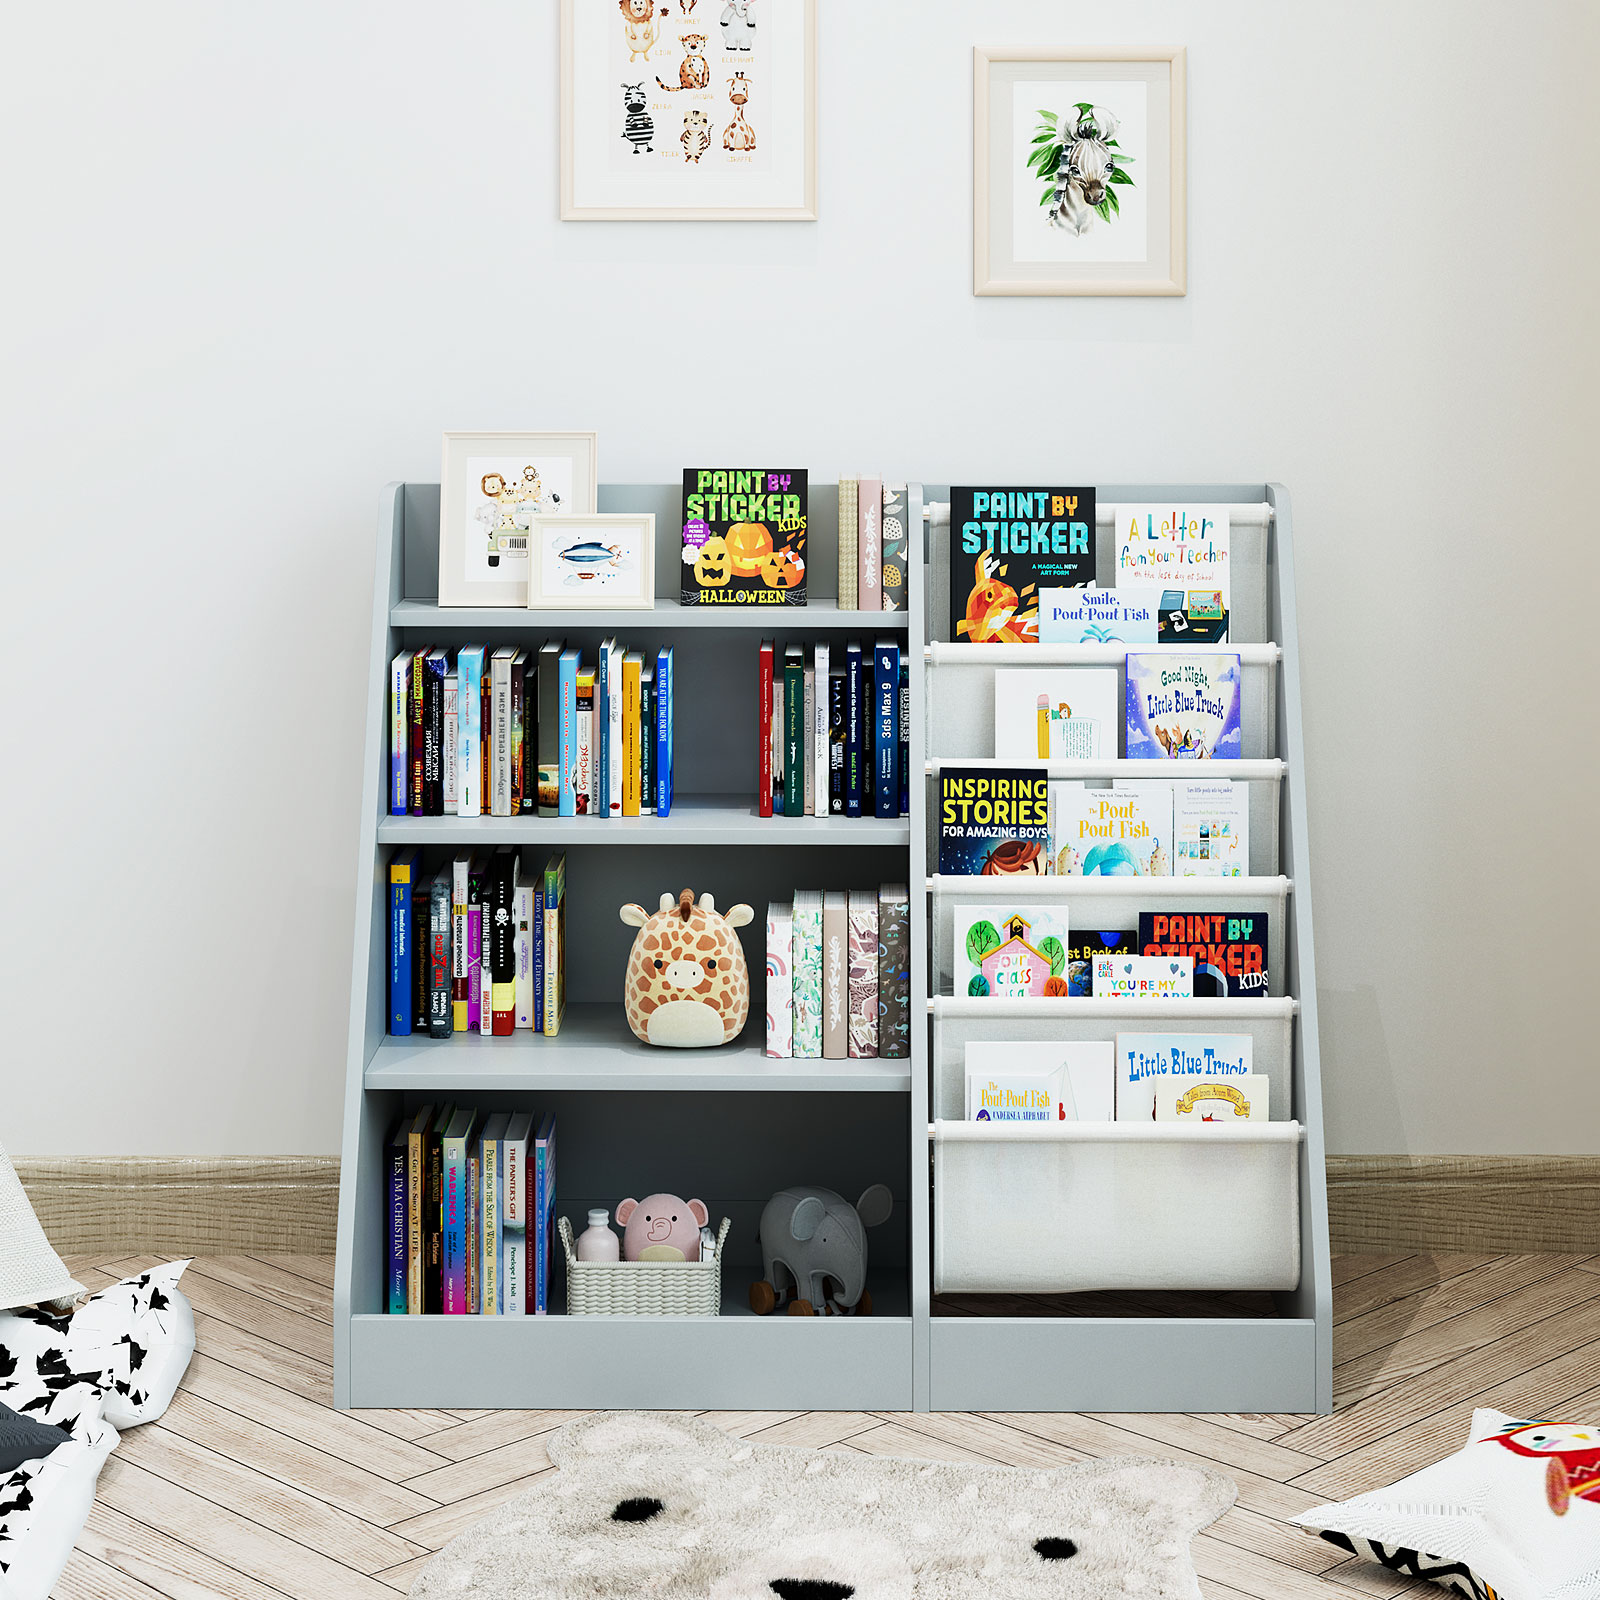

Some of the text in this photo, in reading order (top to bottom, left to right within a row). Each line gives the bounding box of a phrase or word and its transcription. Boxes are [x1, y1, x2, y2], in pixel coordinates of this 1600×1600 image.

[698, 471, 792, 493] PAINT BY
[687, 494, 800, 521] STICKER
[974, 492, 1078, 518] PAINT BY
[778, 516, 807, 532] KIDS
[1129, 512, 1213, 541] A Letter
[962, 522, 1089, 554] STICKER
[1120, 541, 1227, 568] from your Teacher
[699, 590, 786, 603] HALLOWEEN
[1082, 592, 1120, 606] Smile,
[1052, 608, 1149, 621] Pout-Pout Fish
[1161, 666, 1210, 689] Good Night,
[833, 680, 842, 725] HALO
[882, 693, 892, 715] Max
[1148, 690, 1224, 720] Little Blue Truck
[882, 719, 892, 738] 3ds
[579, 744, 589, 790] СуперСЕКС
[944, 778, 1047, 799] INSPIRING
[943, 799, 1047, 825] STORIES
[1098, 801, 1140, 819] Pout-
[943, 826, 1047, 838] FOR AMAZING BOYS
[1078, 820, 1149, 839] Pout Fish
[1153, 915, 1253, 942] PAINT BY
[435, 935, 444, 988] TIME ZERO
[1001, 955, 1027, 968] our
[1068, 946, 1128, 959] st Book of
[1099, 962, 1113, 971] ERIC
[997, 969, 1031, 984] class
[1111, 980, 1175, 990] YOU'RE MY
[1238, 970, 1268, 990] KIDS
[1128, 1048, 1248, 1082] Little Blue Truck
[988, 1081, 998, 1091] The
[981, 1089, 1050, 1108] Pout-Pout Fish
[394, 1156, 403, 1175] YES,
[486, 1149, 494, 1171] PEARLS
[394, 1178, 403, 1194] I'M
[486, 1172, 494, 1189] FROM
[449, 1166, 457, 1225] WABLENICA
[486, 1191, 494, 1202] THE
[412, 1214, 418, 1226] AT
[486, 1204, 494, 1219] SEAT
[394, 1203, 403, 1260] CHRISTIAN!
[486, 1231, 494, 1256] WISDOM
